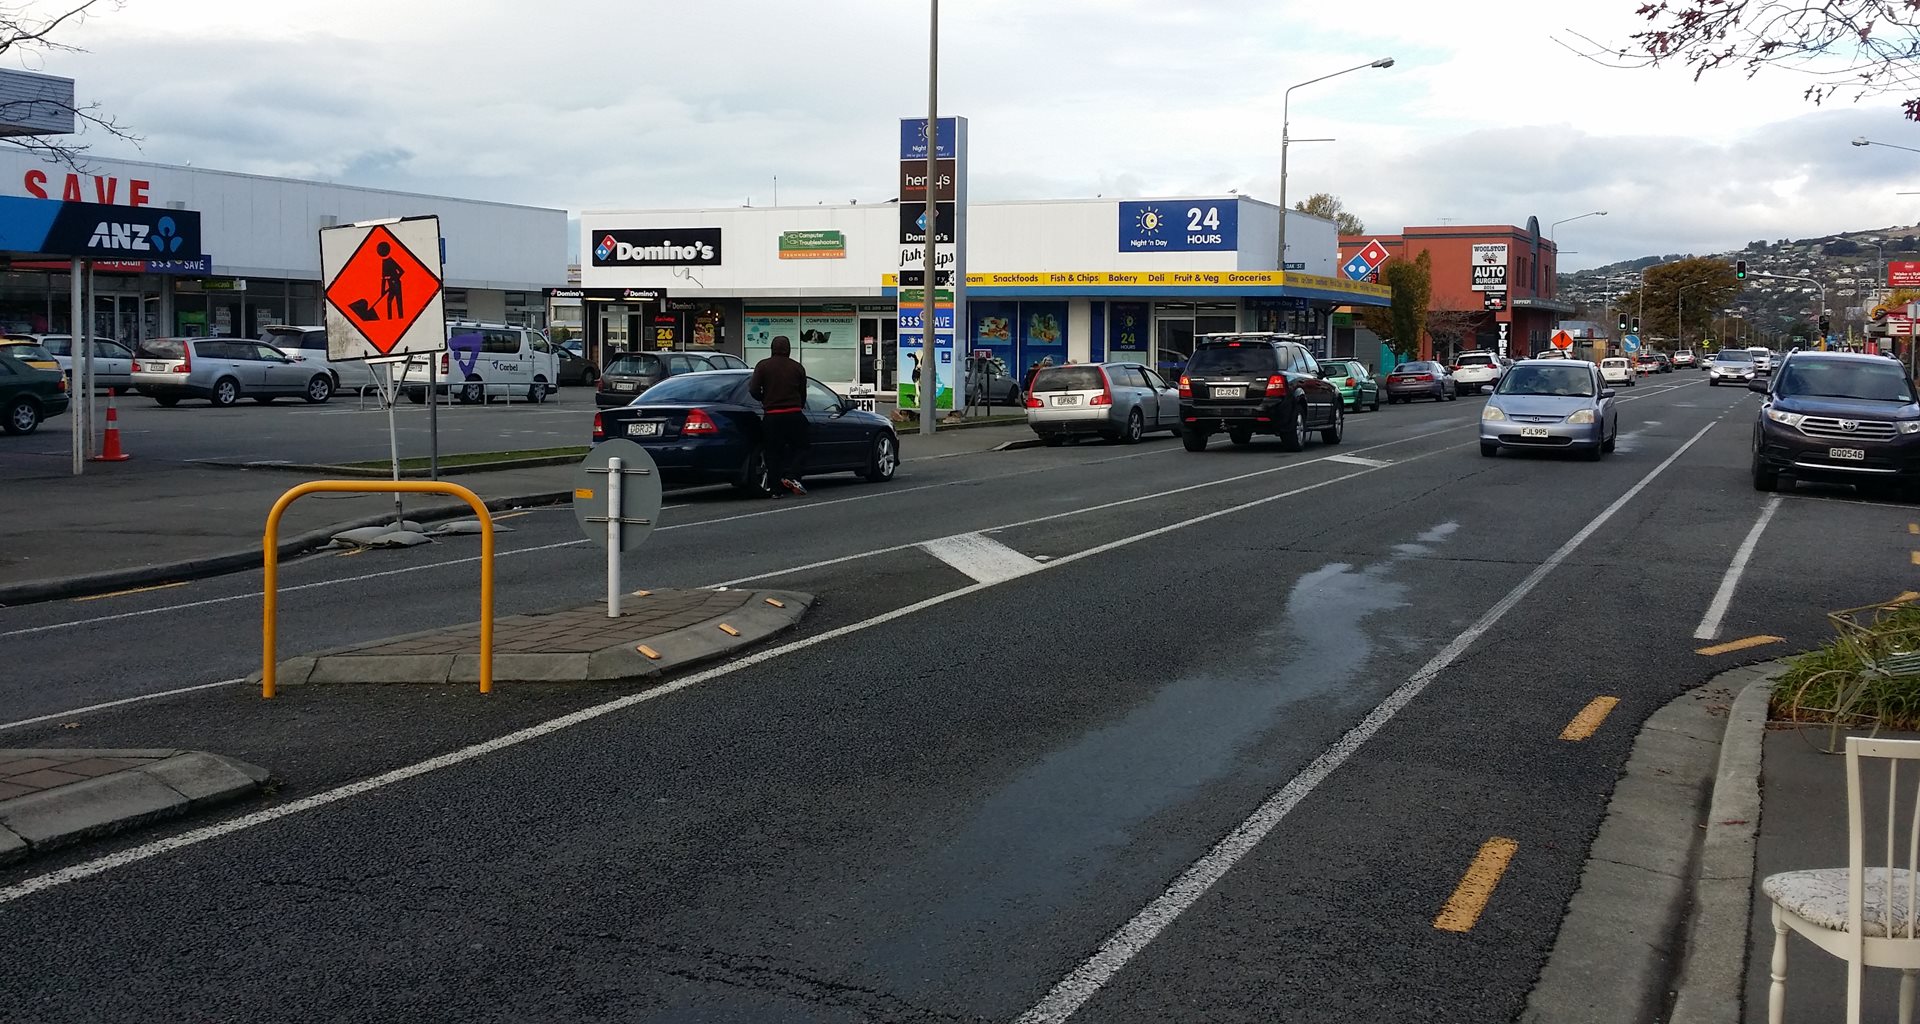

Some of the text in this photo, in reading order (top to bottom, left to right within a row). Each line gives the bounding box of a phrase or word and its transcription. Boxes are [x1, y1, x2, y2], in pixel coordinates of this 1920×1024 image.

[905, 173, 950, 190] heny's
[24, 169, 150, 207] SAVE
[1187, 207, 1220, 231] 24
[88, 221, 150, 250] ANZ
[905, 232, 948, 241] Domo's
[1187, 234, 1221, 244] HOURS
[1155, 239, 1168, 247] Day
[616, 240, 714, 261] Domino's
[900, 248, 922, 267] fish
[184, 260, 204, 270] SAVE
[1228, 273, 1272, 282] Groceries
[1474, 266, 1505, 278] AUTO
[993, 275, 1039, 283] Snackfoods
[1050, 274, 1066, 282] Fish
[1076, 273, 1099, 284] Chips
[1108, 274, 1138, 284] Bakery
[1148, 274, 1165, 282] Deli
[1174, 273, 1219, 284] Fruit & Veg
[672, 302, 696, 310] Domino's
[933, 316, 950, 327] AVE
[1121, 333, 1136, 344] 24
[500, 363, 519, 372] Corbel
[856, 400, 873, 412] PEN
